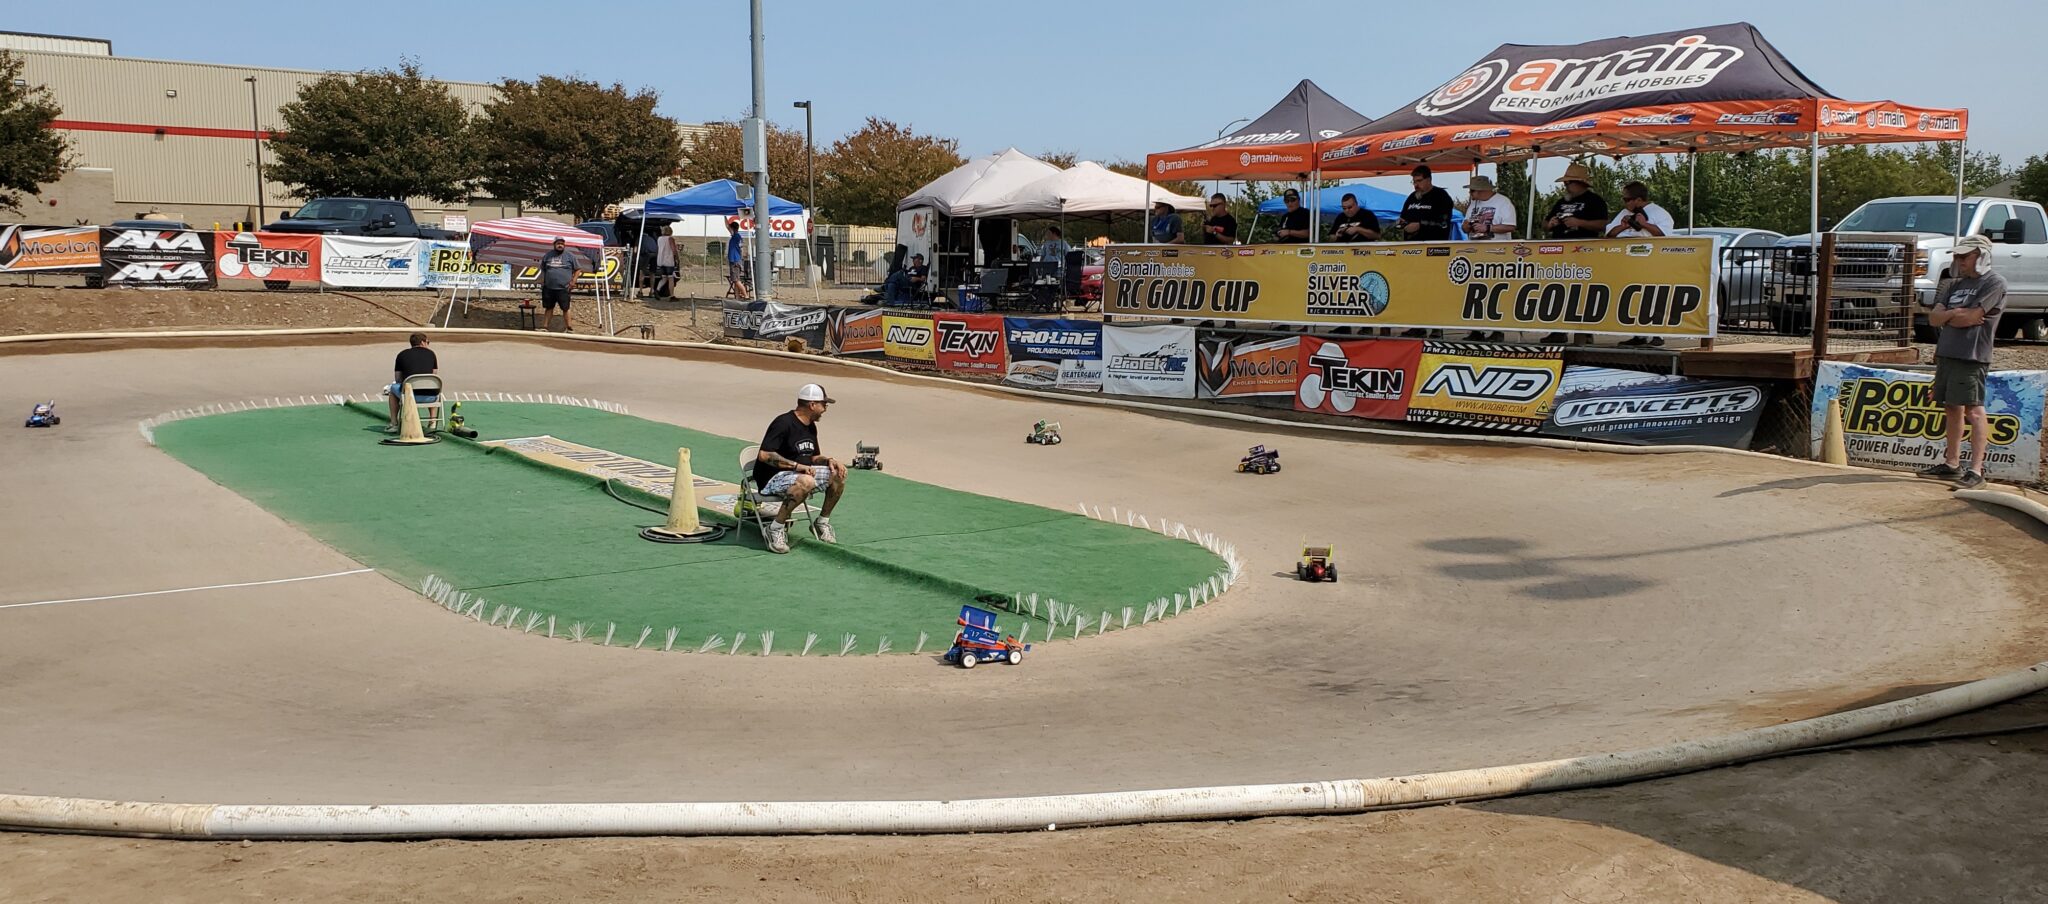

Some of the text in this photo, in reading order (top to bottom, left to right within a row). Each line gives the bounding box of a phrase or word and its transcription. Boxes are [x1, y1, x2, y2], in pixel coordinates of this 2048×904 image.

[1508, 37, 1737, 92] amain
[1496, 73, 1710, 109] PERFORMANCE HOBBIES
[1878, 109, 1907, 128] amain
[728, 215, 795, 231] COCO
[21, 240, 98, 255] Maclan
[103, 230, 206, 250] AKA
[226, 241, 309, 266] TEKIN
[1123, 258, 1195, 277] amainhobbies
[1319, 261, 1347, 273] amain
[1473, 257, 1592, 280] amainhobbies
[1308, 275, 1359, 290] SILVER
[1117, 279, 1260, 313] RC GOLD CUP
[1308, 292, 1373, 316] DOLLAR
[1462, 283, 1701, 326] RC GOLD CUP
[886, 326, 931, 347] AVID
[937, 321, 999, 357] TEKIN
[1027, 347, 1096, 356] PROLINERACING.com
[1231, 356, 1299, 377] Maclan
[1310, 355, 1404, 393] TEKIN
[1418, 364, 1553, 402] AVID
[1560, 391, 1752, 420] JCONCEPTS
[1581, 424, 1605, 433] world
[1609, 422, 1639, 433] proven
[1642, 418, 1692, 428] innovation
[1707, 415, 1741, 425] design
[1850, 438, 1889, 454] POWER
[1892, 440, 1920, 457] Used
[1923, 444, 1942, 461] By
